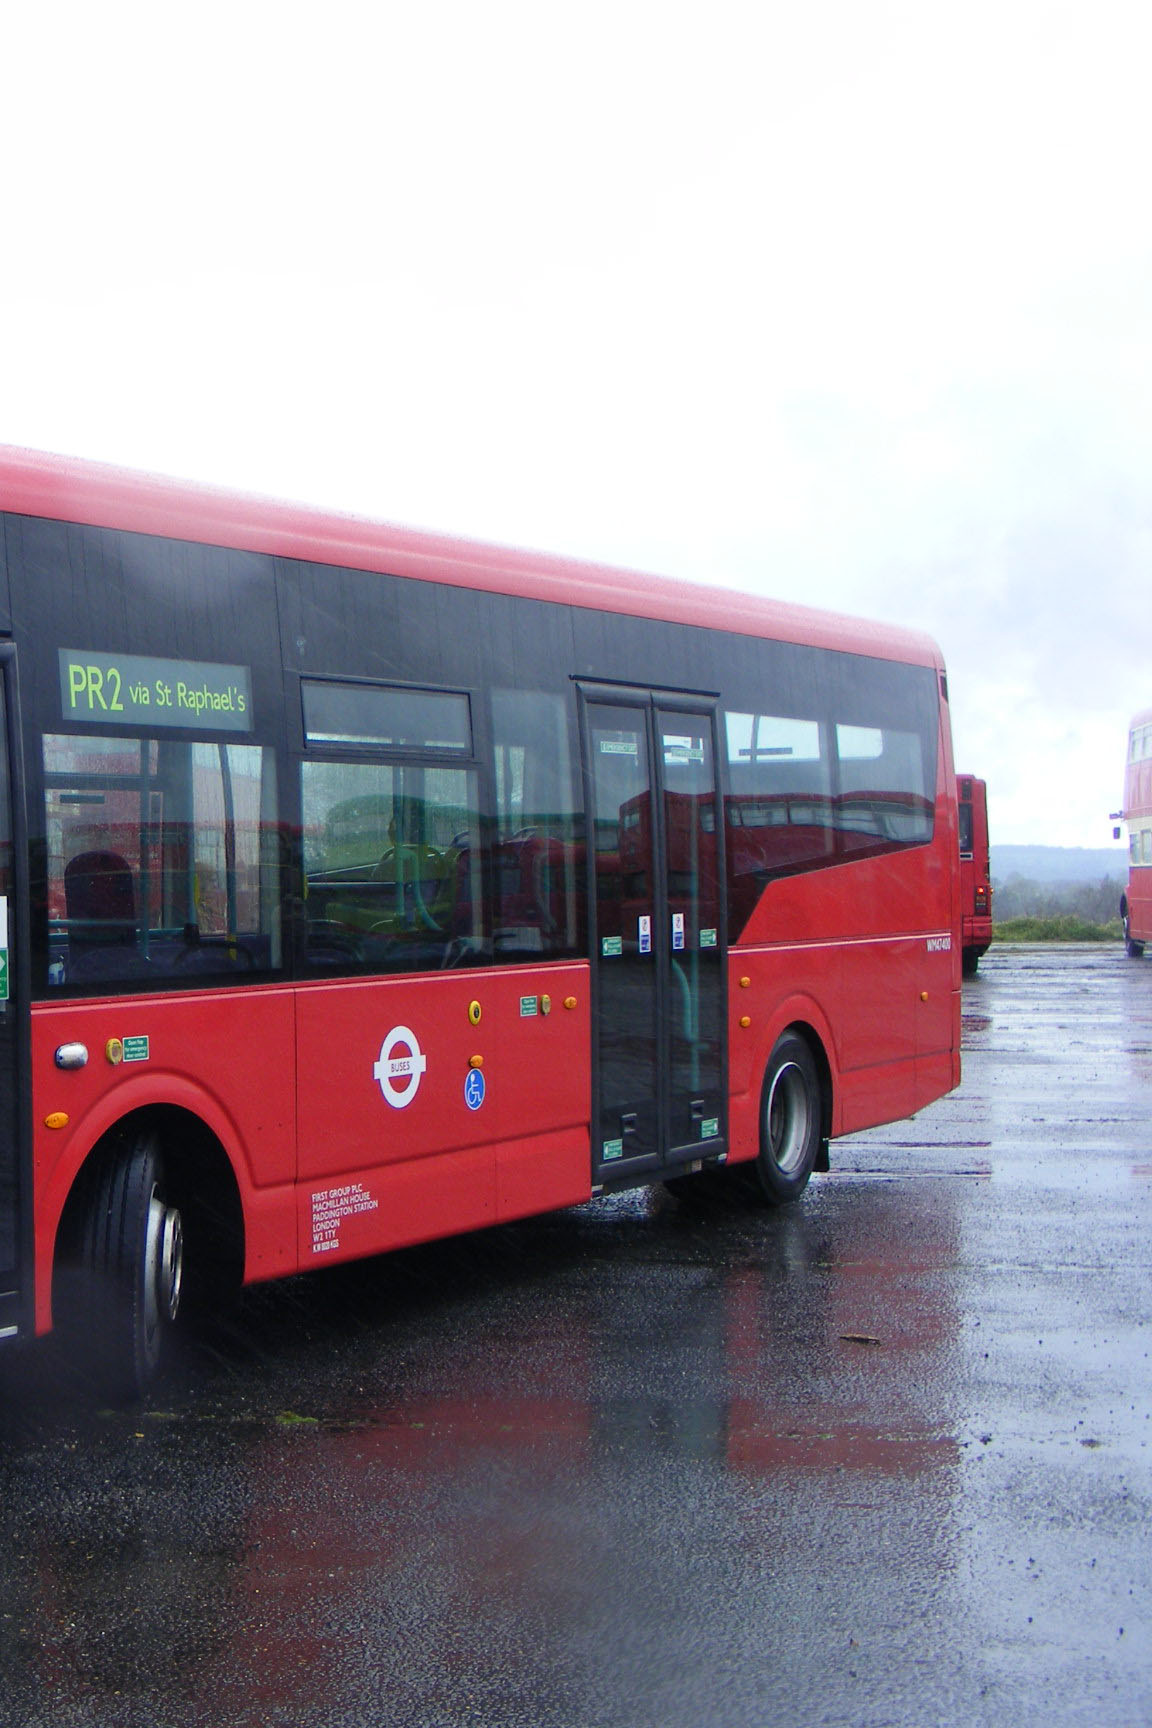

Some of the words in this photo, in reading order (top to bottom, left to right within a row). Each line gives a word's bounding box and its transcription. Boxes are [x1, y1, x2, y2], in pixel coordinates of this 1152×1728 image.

[69, 664, 124, 711] PR2
[129, 681, 150, 705] via
[155, 680, 172, 706] St
[177, 682, 246, 716] Raphael's
[391, 1061, 410, 1073] BUSES
[312, 1192, 328, 1202] FIRST
[329, 1187, 350, 1198] GROUP
[351, 1183, 363, 1194] PLC
[312, 1196, 349, 1212] MACMILLAN
[349, 1191, 370, 1204] HOUSE
[312, 1205, 353, 1223] PADDINGTON
[354, 1200, 378, 1213] STATION
[312, 1218, 341, 1233] LONDON
[313, 1233, 323, 1242] W2
[325, 1229, 336, 1239] 1TY
